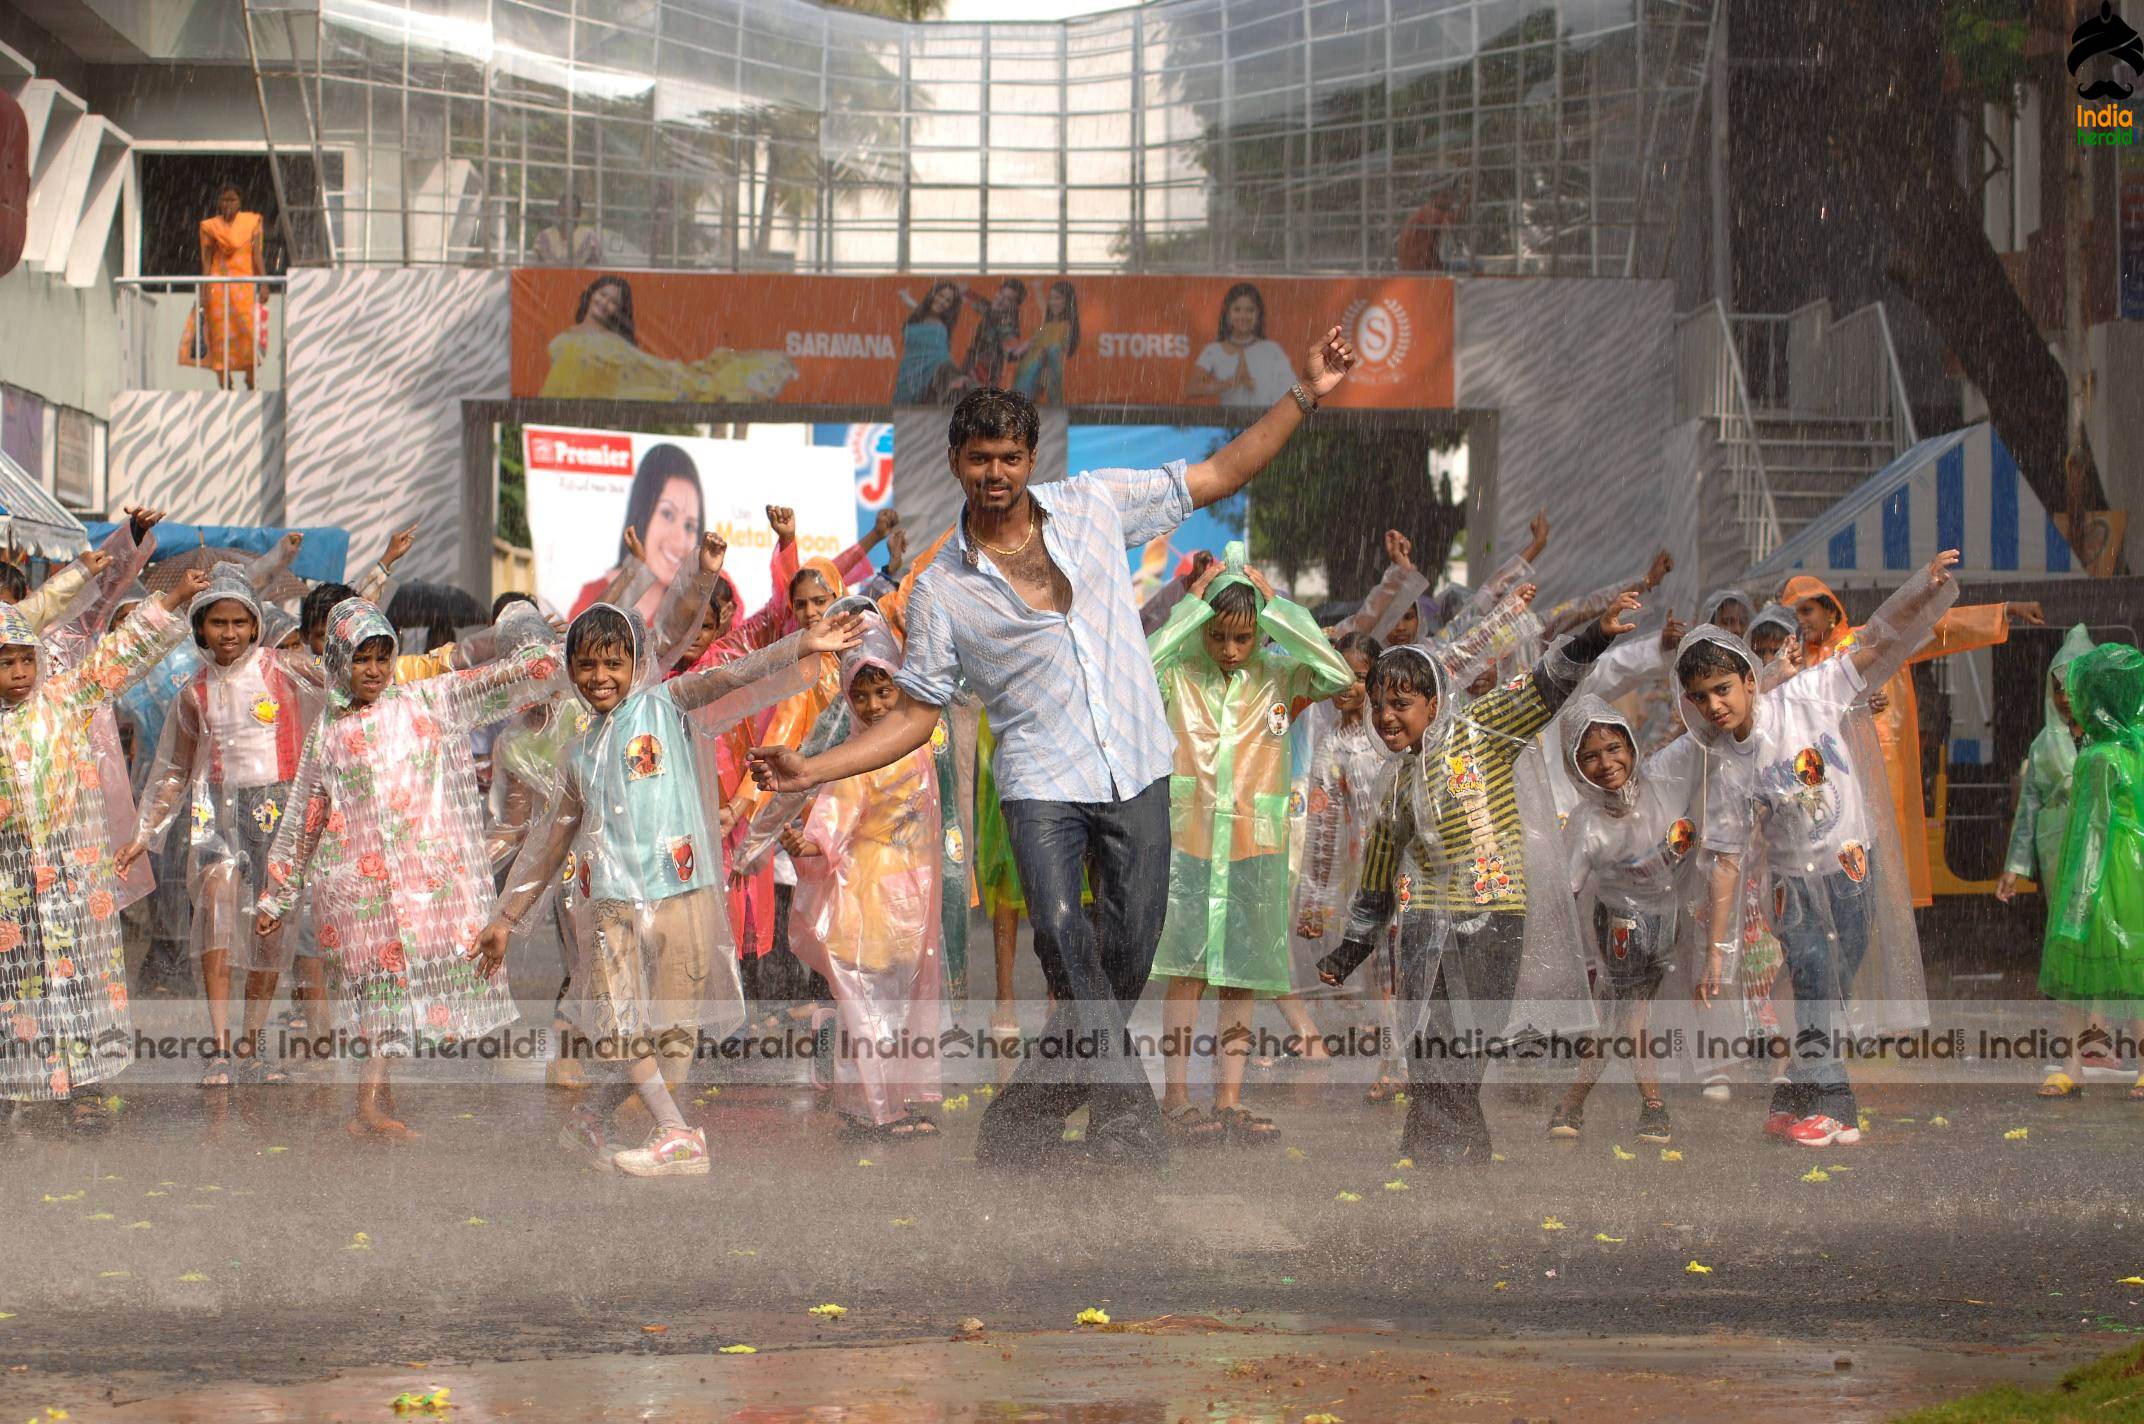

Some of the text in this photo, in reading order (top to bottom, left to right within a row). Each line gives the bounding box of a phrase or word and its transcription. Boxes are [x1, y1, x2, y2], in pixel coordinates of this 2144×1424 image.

[785, 331, 1191, 359] SARAVANA STORES
[553, 440, 630, 468] Premier
[714, 520, 773, 549] Metal
